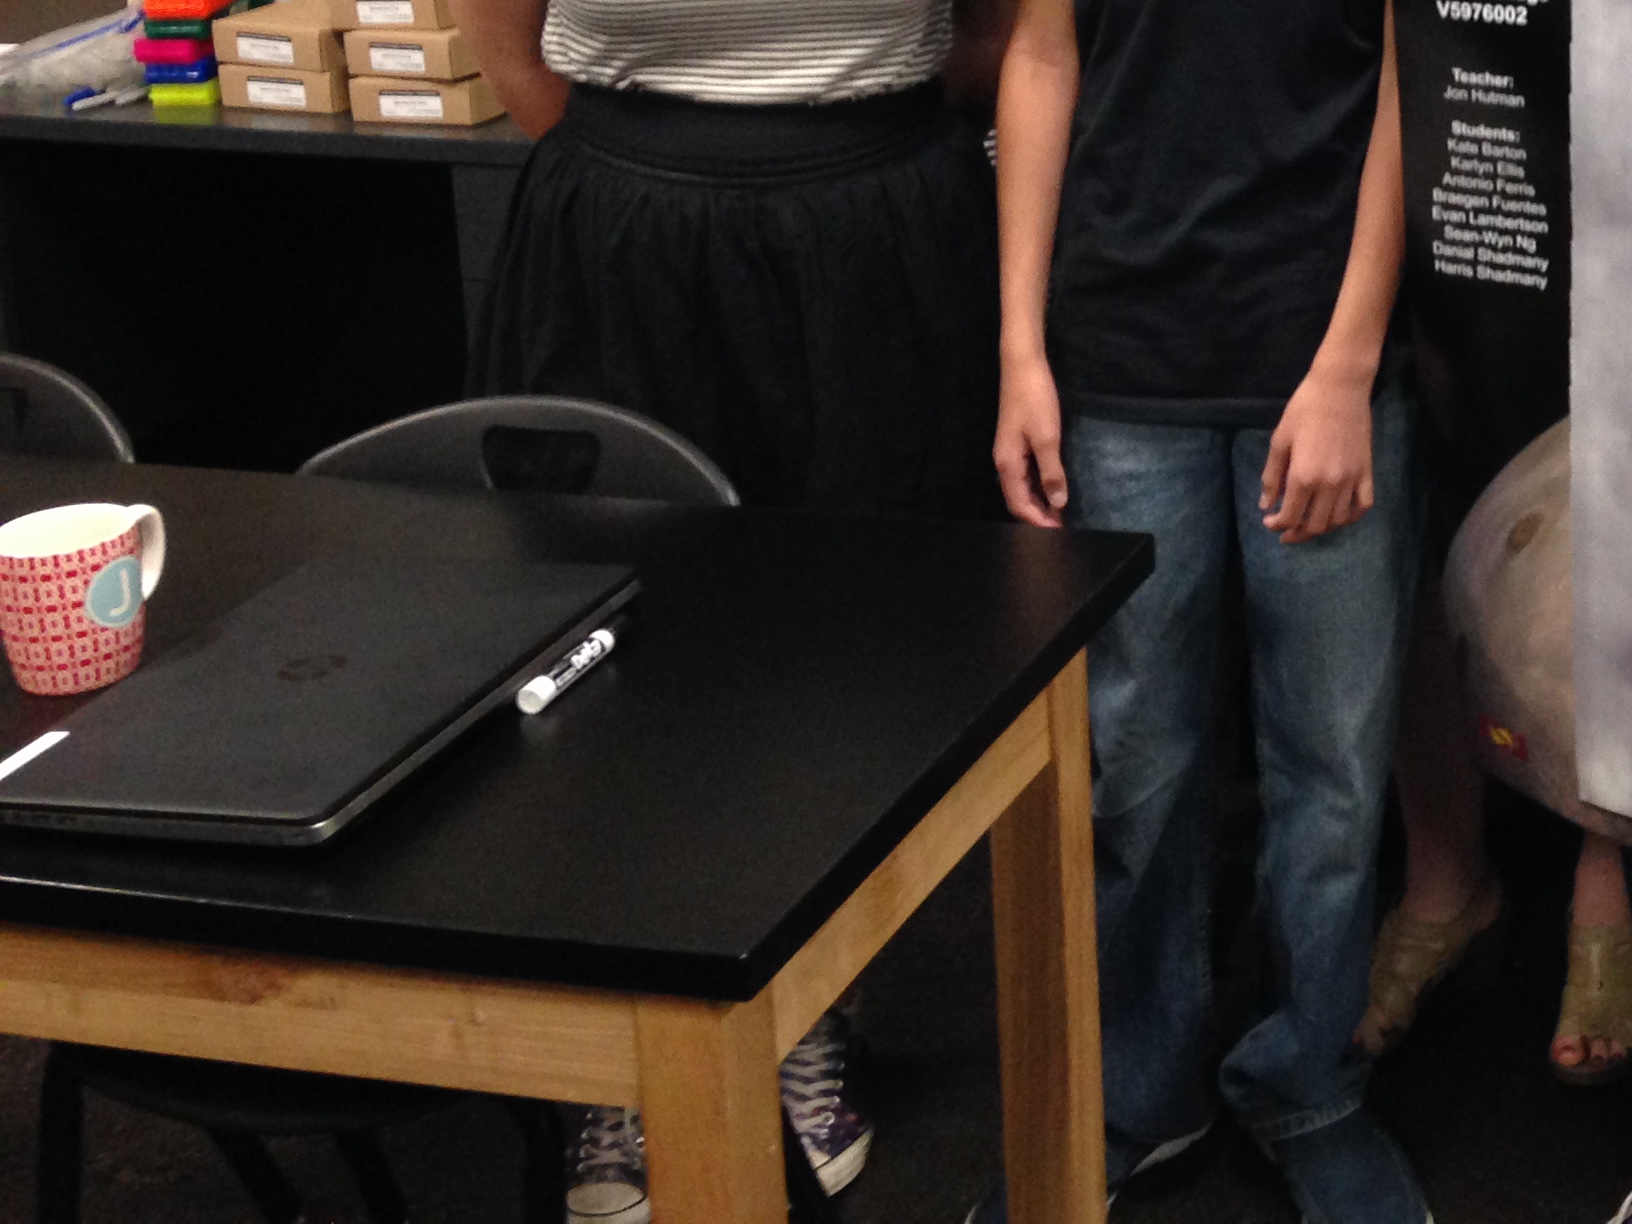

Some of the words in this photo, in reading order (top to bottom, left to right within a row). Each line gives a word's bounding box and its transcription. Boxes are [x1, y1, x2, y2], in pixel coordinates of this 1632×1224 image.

[1436, 0, 1529, 26] V5976002
[1443, 85, 1468, 101] Jon
[1451, 119, 1521, 144] Students:
[1442, 172, 1494, 191] Antonio
[1432, 204, 1466, 224] Evan
[1516, 233, 1537, 255] Ng
